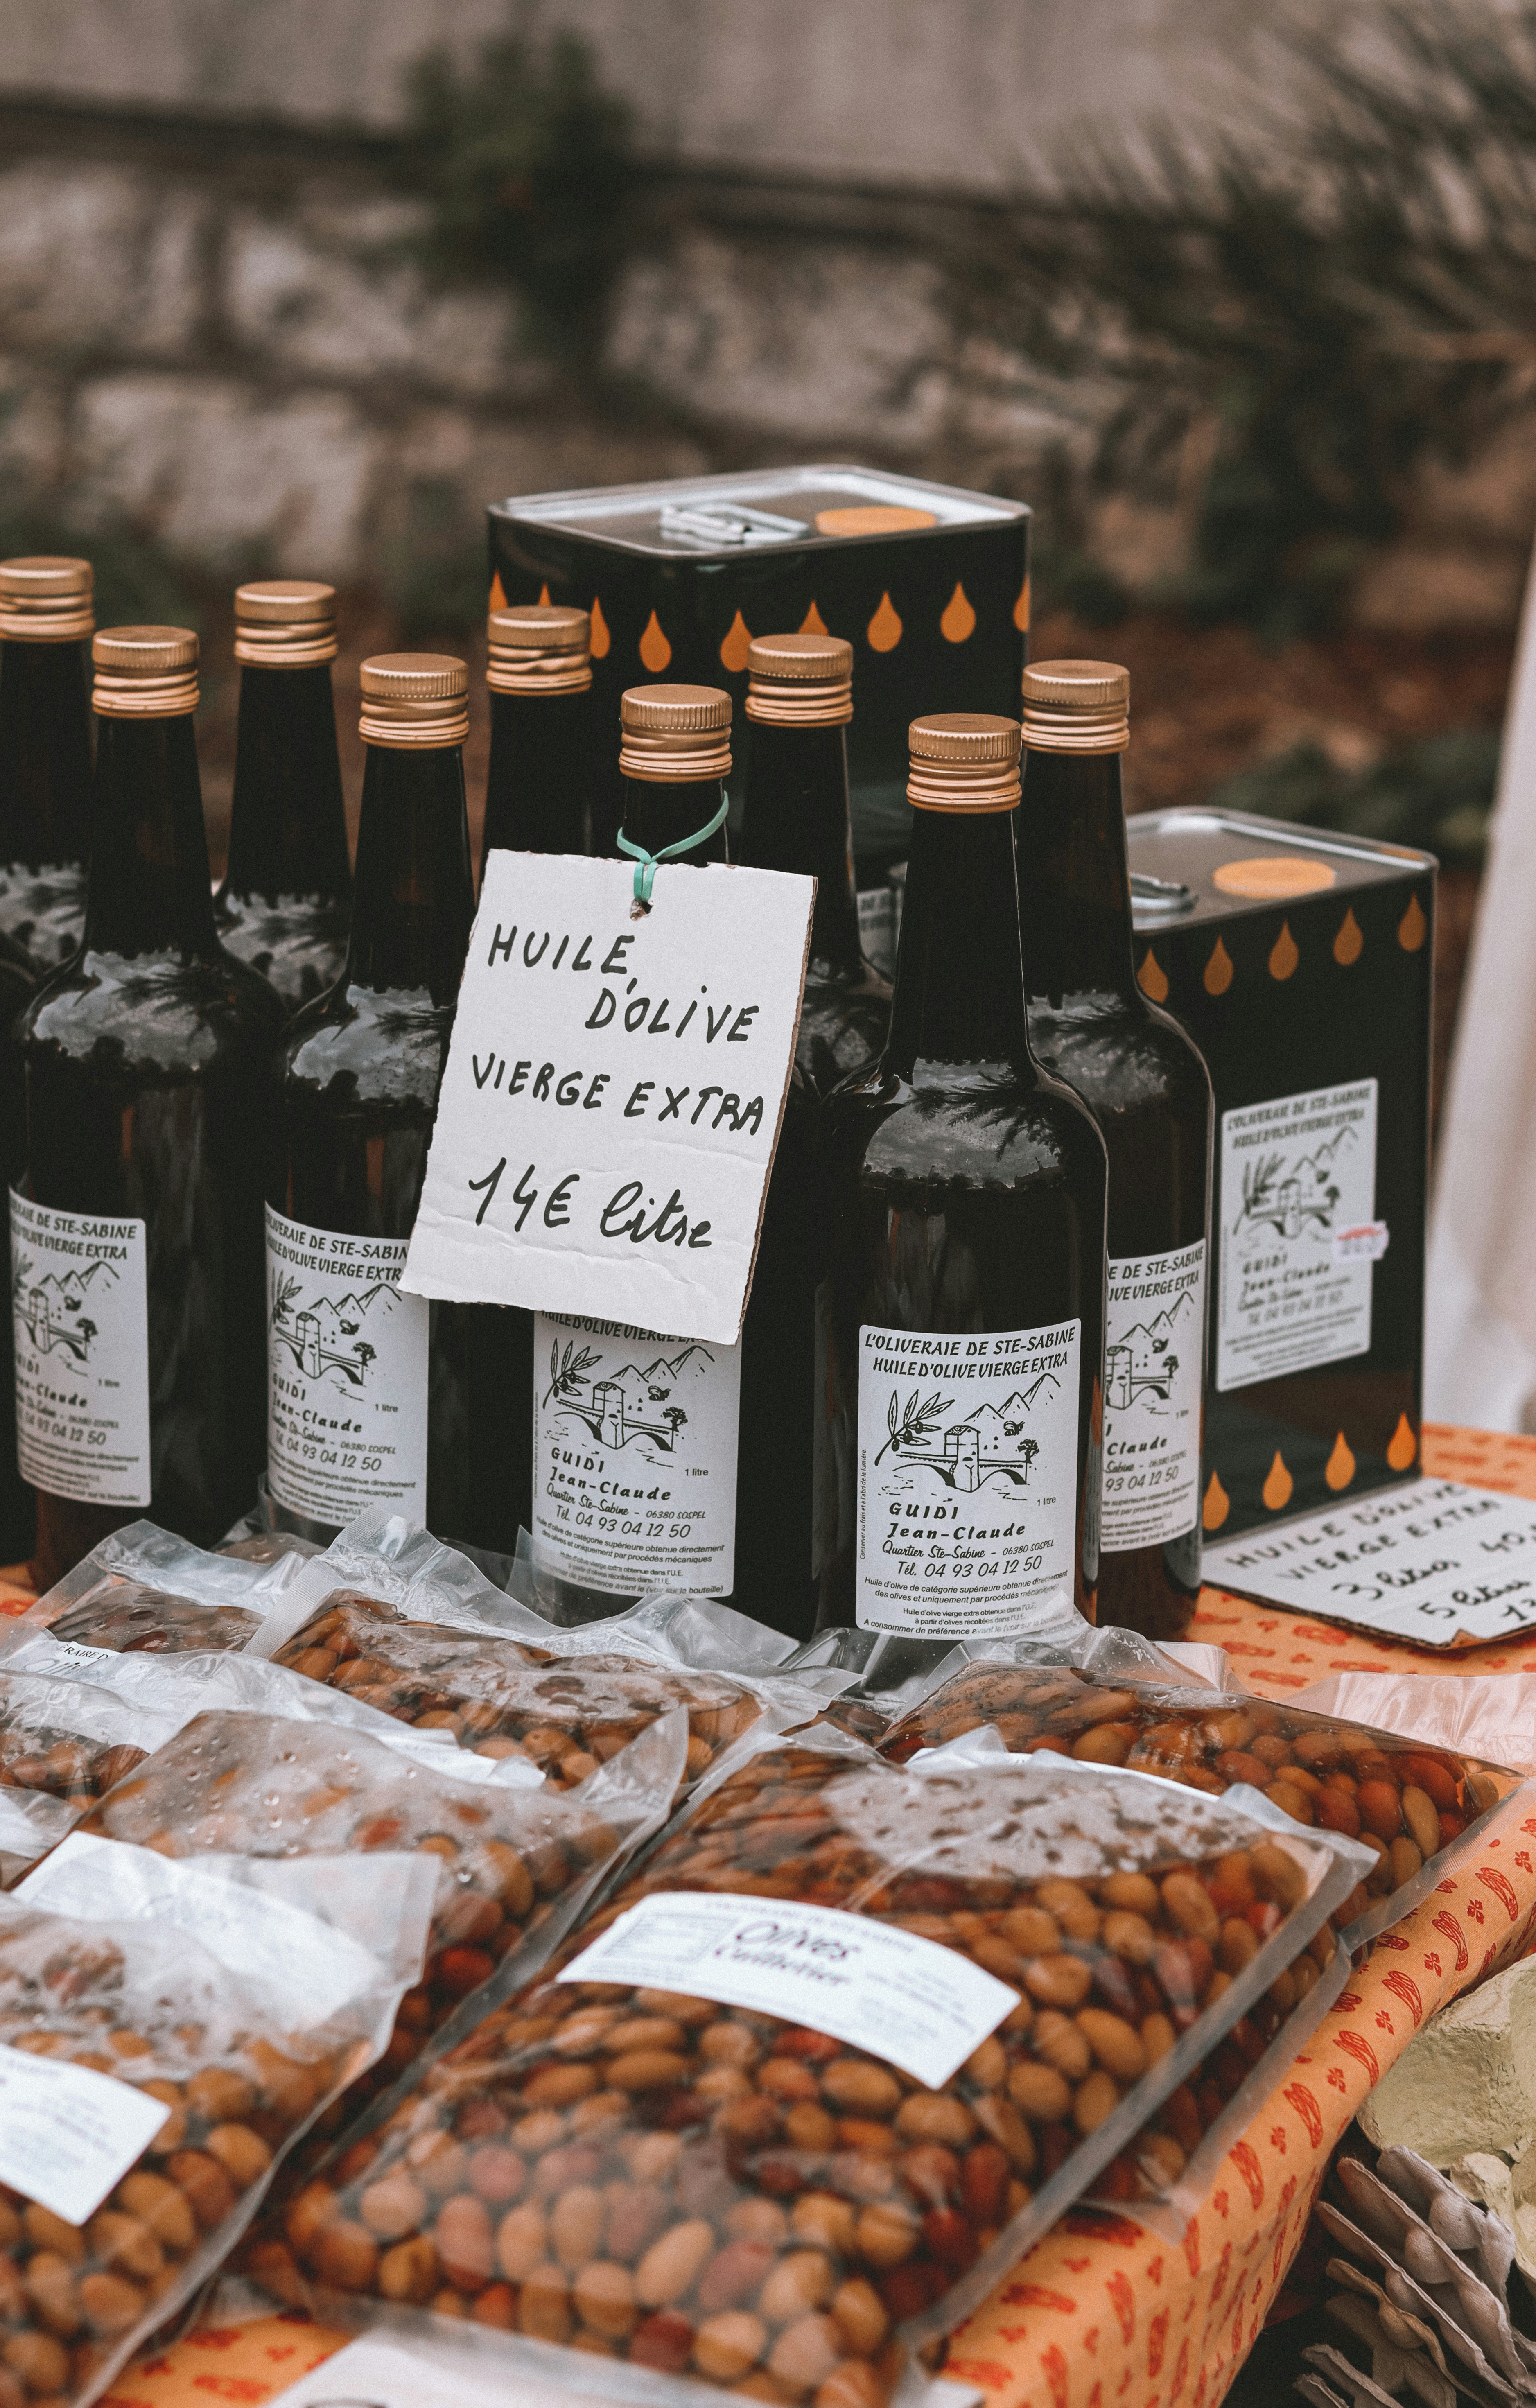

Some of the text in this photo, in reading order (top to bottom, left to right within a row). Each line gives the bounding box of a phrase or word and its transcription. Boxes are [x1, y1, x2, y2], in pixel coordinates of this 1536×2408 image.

[488, 923, 635, 974] HUILE
[585, 977, 760, 1044] D'OLIVE
[472, 1053, 765, 1136] VIERGE EXTRA
[468, 1157, 713, 1249] 14€ litre
[54, 1217, 138, 1240] STE-SABINE
[45, 1236, 127, 1260] VIERGE EXTRA
[309, 1235, 408, 1260] DE STE-SABIN
[282, 1245, 402, 1281] D'OLIVE VIERGE EXTR
[1122, 1264, 1142, 1279] DE
[1145, 1246, 1204, 1276] STE-SABINE
[1133, 1279, 1174, 1299] VIERGE
[1175, 1270, 1199, 1292] EXTRA
[573, 1317, 622, 1337] D'OLIVE
[865, 1326, 1076, 1356] L'OLIVERAIE DE STE-SABINE
[873, 1351, 1067, 1378] HUILE D'OLIVE VIERGE EXTRA
[303, 1444, 316, 1459] 93
[320, 1450, 338, 1465] 04
[341, 1454, 357, 1468] 12
[361, 1457, 382, 1471] 50
[1107, 1436, 1167, 1455] Claude
[552, 1447, 605, 1473] GUIDI
[550, 1466, 671, 1500] Jean-Claude
[1106, 1466, 1179, 1492] 93 04 12 50
[889, 1502, 959, 1520] GUIDI
[1043, 1497, 1056, 1505] litre
[576, 1512, 594, 1527] 04
[599, 1517, 617, 1532] 93
[621, 1521, 642, 1535] 04
[646, 1524, 664, 1537] 12
[669, 1525, 691, 1538] 50
[646, 1510, 675, 1519] 06380
[677, 1511, 706, 1519] SOSPEL
[888, 1523, 1025, 1540] Jean-Claude
[604, 1541, 644, 1552] supérieure
[679, 1545, 725, 1553] directement
[614, 1552, 627, 1560] par
[882, 1539, 1055, 1559] Quartier Ste-Sabine 06380 SOSPEL
[898, 1556, 1042, 1578] Tél. 04 93 04 12 50
[865, 1577, 882, 1586] Huile
[884, 1581, 908, 1590] d'olive
[921, 1586, 958, 1594] catégorie
[960, 1585, 1001, 1594] supérieure
[1002, 1581, 1031, 1590] obtenue
[890, 1593, 911, 1601] olives
[984, 1592, 1019, 1604] procédés
[1020, 1583, 1059, 1597] mécani
[871, 1621, 915, 1632] consommer
[928, 1628, 970, 1637] préférence
